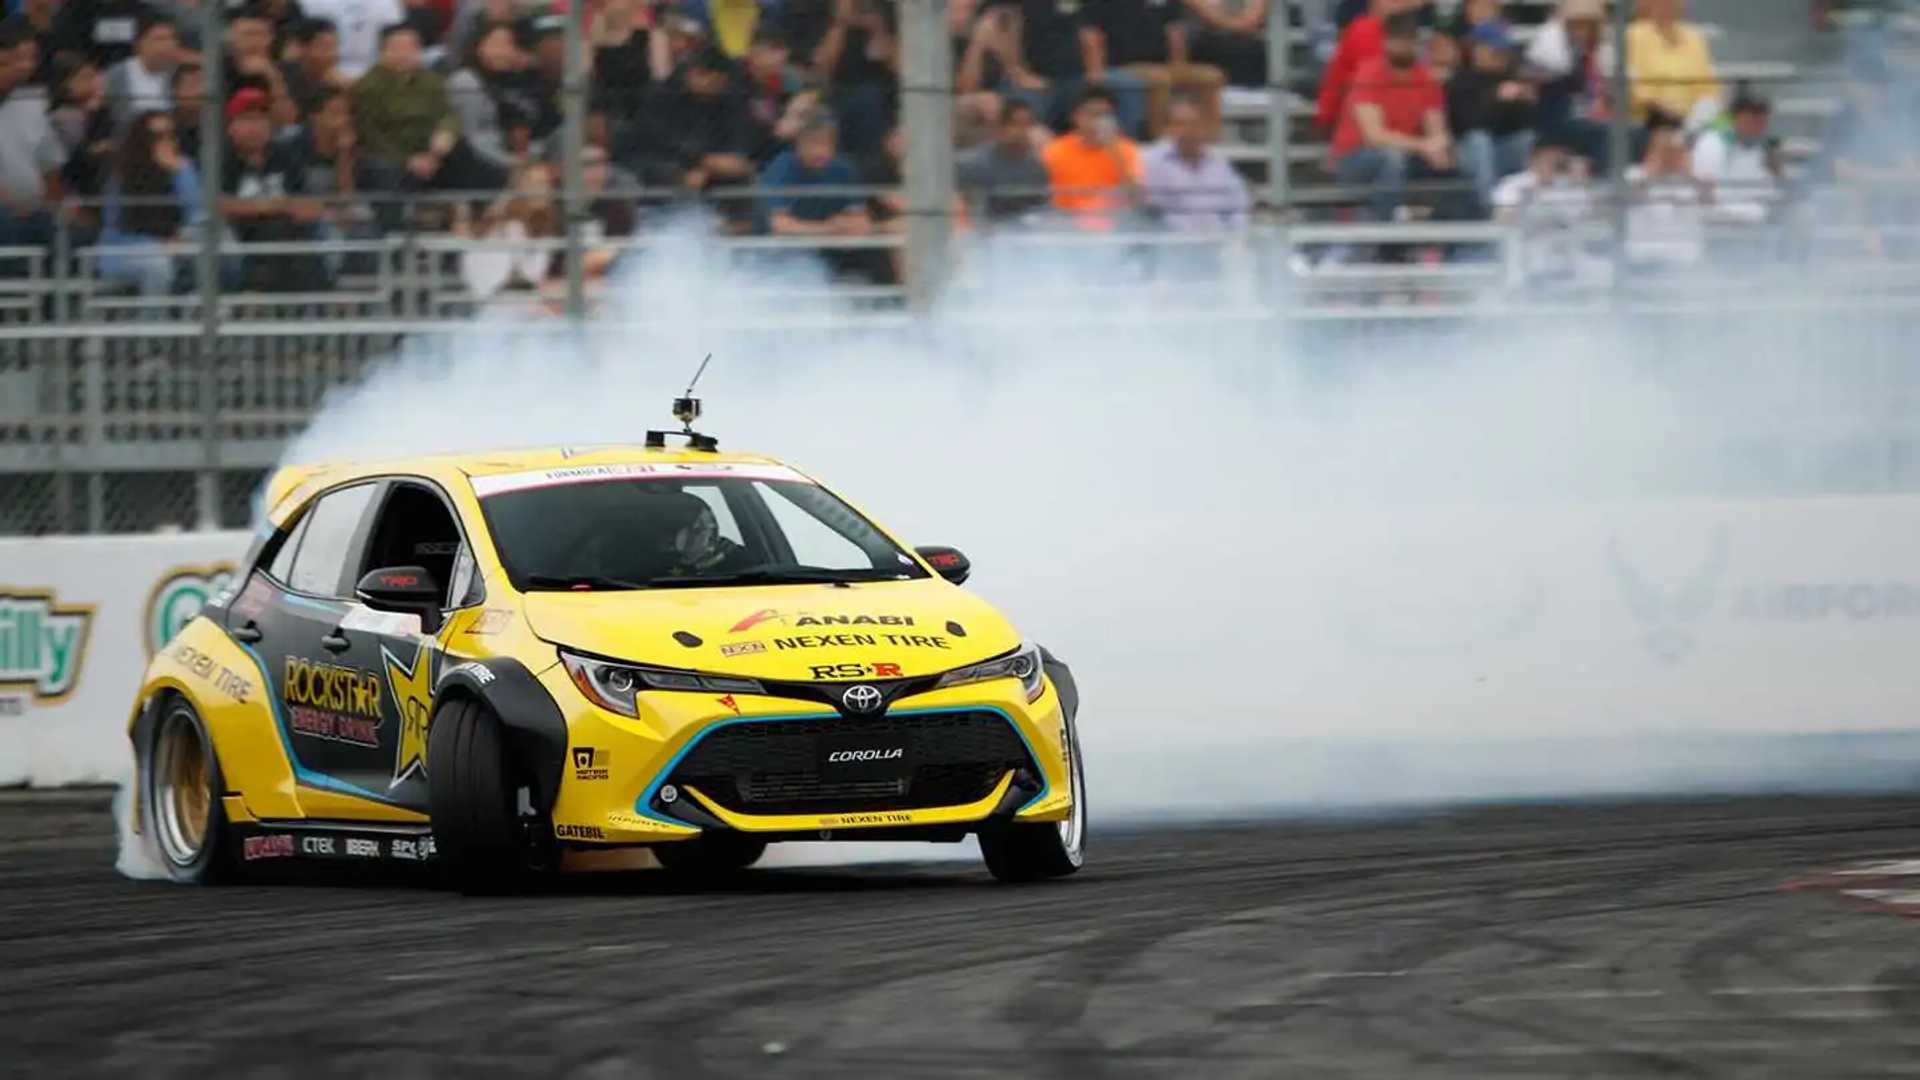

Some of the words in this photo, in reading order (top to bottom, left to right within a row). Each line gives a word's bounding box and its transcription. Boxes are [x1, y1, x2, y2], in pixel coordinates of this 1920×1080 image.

[796, 614, 915, 627] ANABI
[774, 634, 876, 651] NEXEN
[881, 634, 952, 650] TIRE
[213, 666, 254, 705] TIRE
[828, 748, 903, 763] COROLLA
[840, 814, 883, 825] NEXEN
[556, 823, 607, 840] GATEBIL
[302, 836, 335, 853] CTEK
